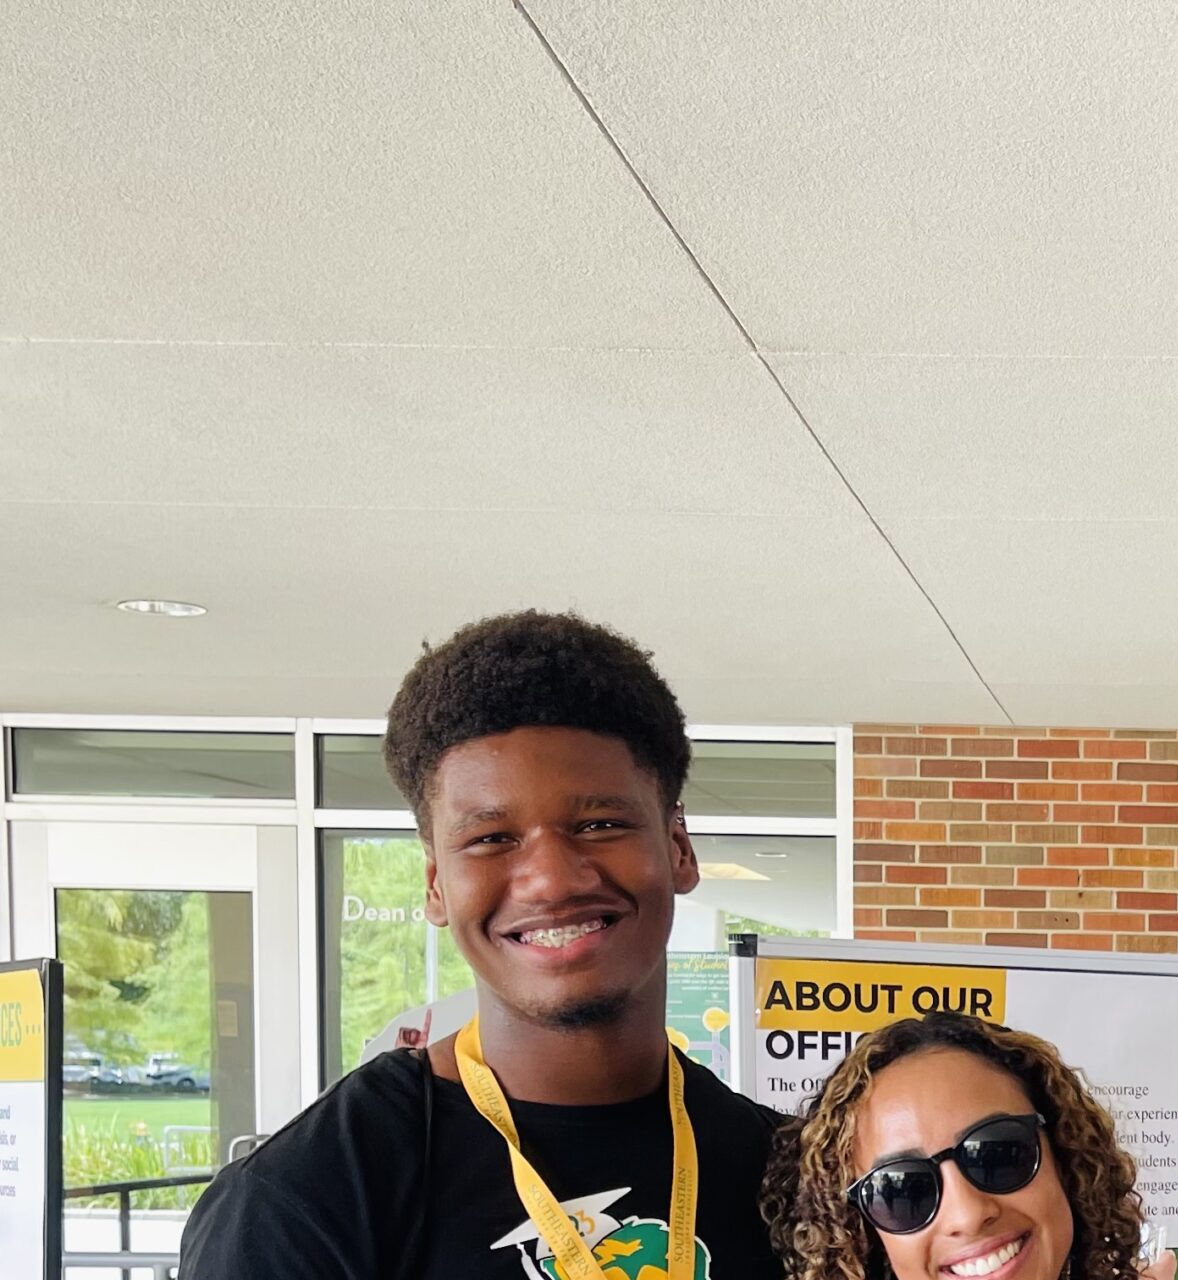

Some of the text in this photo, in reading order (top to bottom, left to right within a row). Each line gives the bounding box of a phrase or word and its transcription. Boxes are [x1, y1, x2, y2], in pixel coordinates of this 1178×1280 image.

[343, 895, 405, 921] Dean
[764, 980, 993, 1018] ABOUT OUR
[766, 1029, 868, 1061] OFFI
[768, 1077, 797, 1092] The
[528, 1184, 593, 1277] SOUTHEASTERN
[674, 1166, 687, 1264] SOUTHEASTERN
